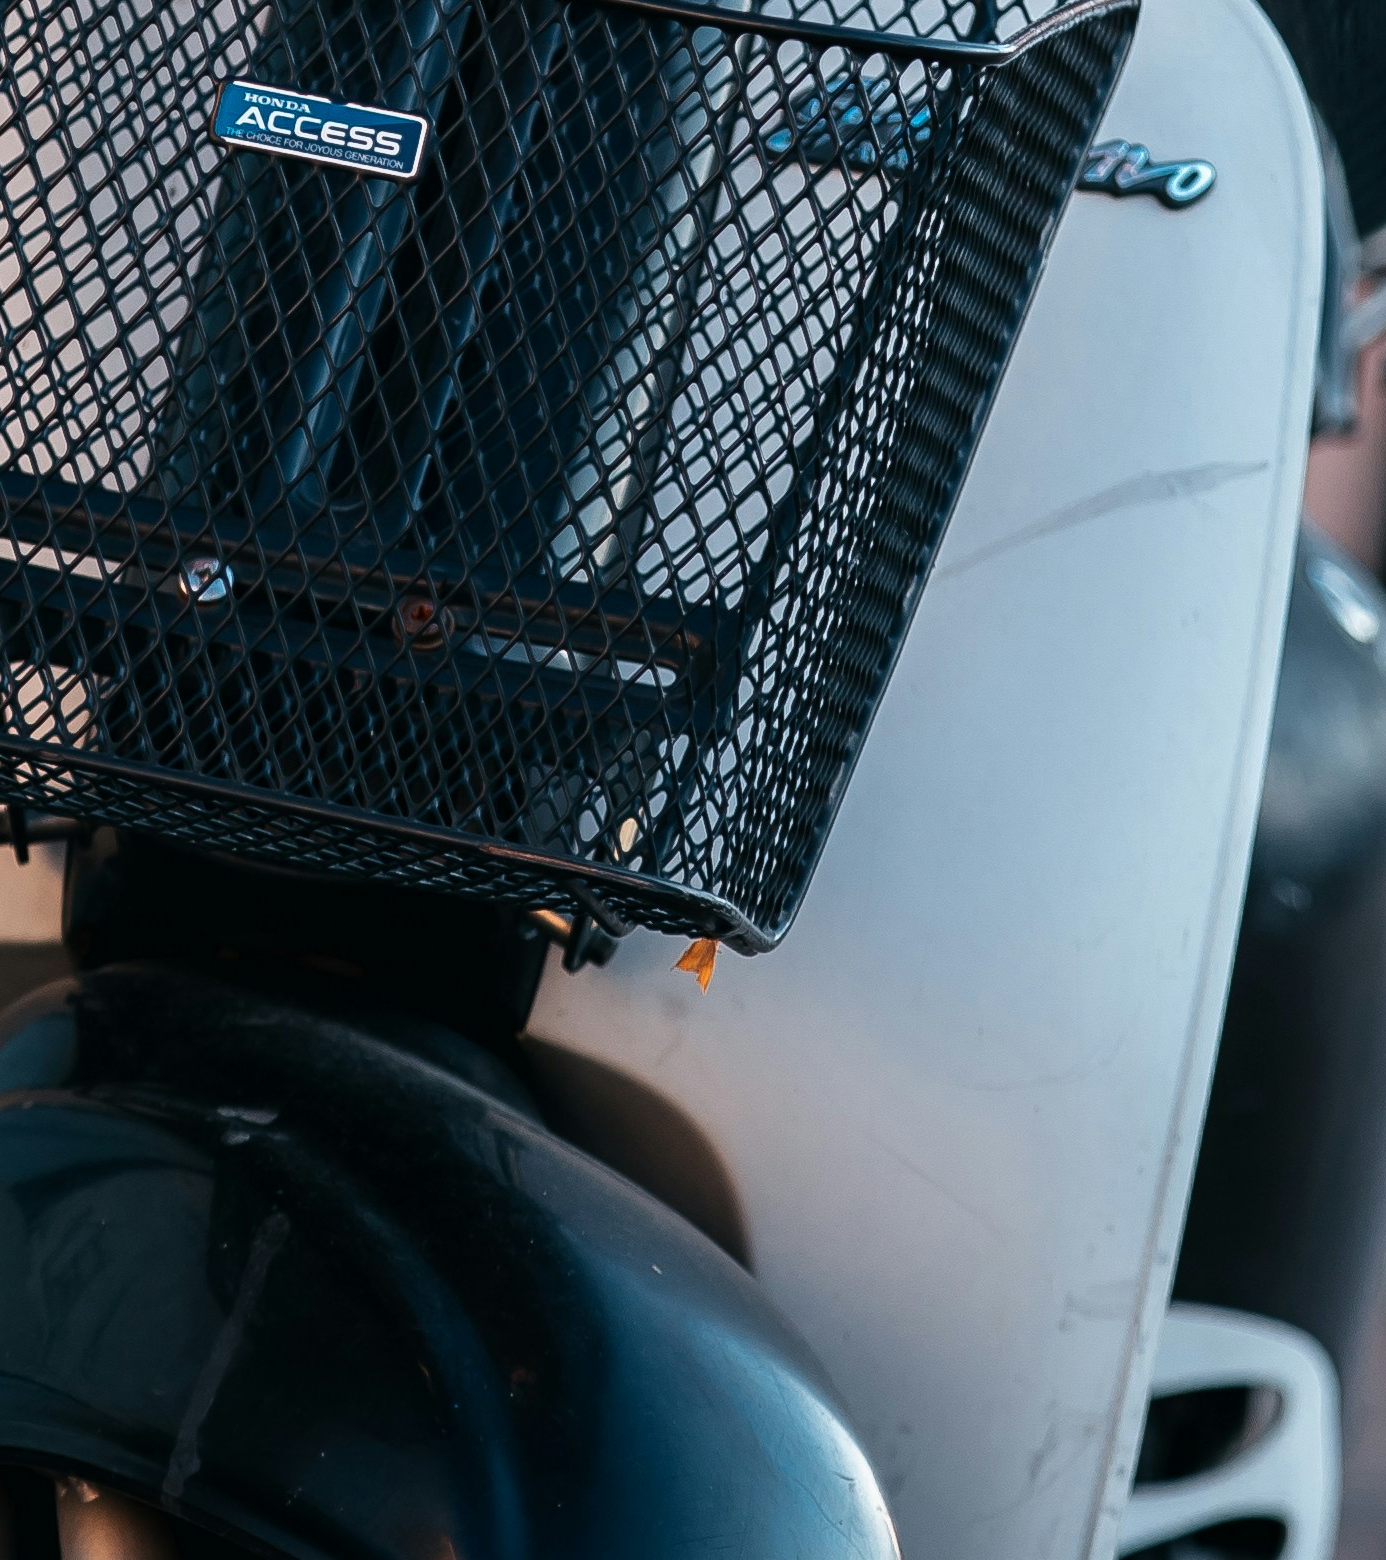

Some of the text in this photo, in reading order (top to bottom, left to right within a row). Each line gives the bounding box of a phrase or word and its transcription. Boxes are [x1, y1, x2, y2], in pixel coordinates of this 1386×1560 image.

[244, 92, 311, 114] HONDA
[225, 126, 404, 170] THE CHOICE FOR JOYOUS GENERATION
[235, 106, 403, 156] ACCESS
